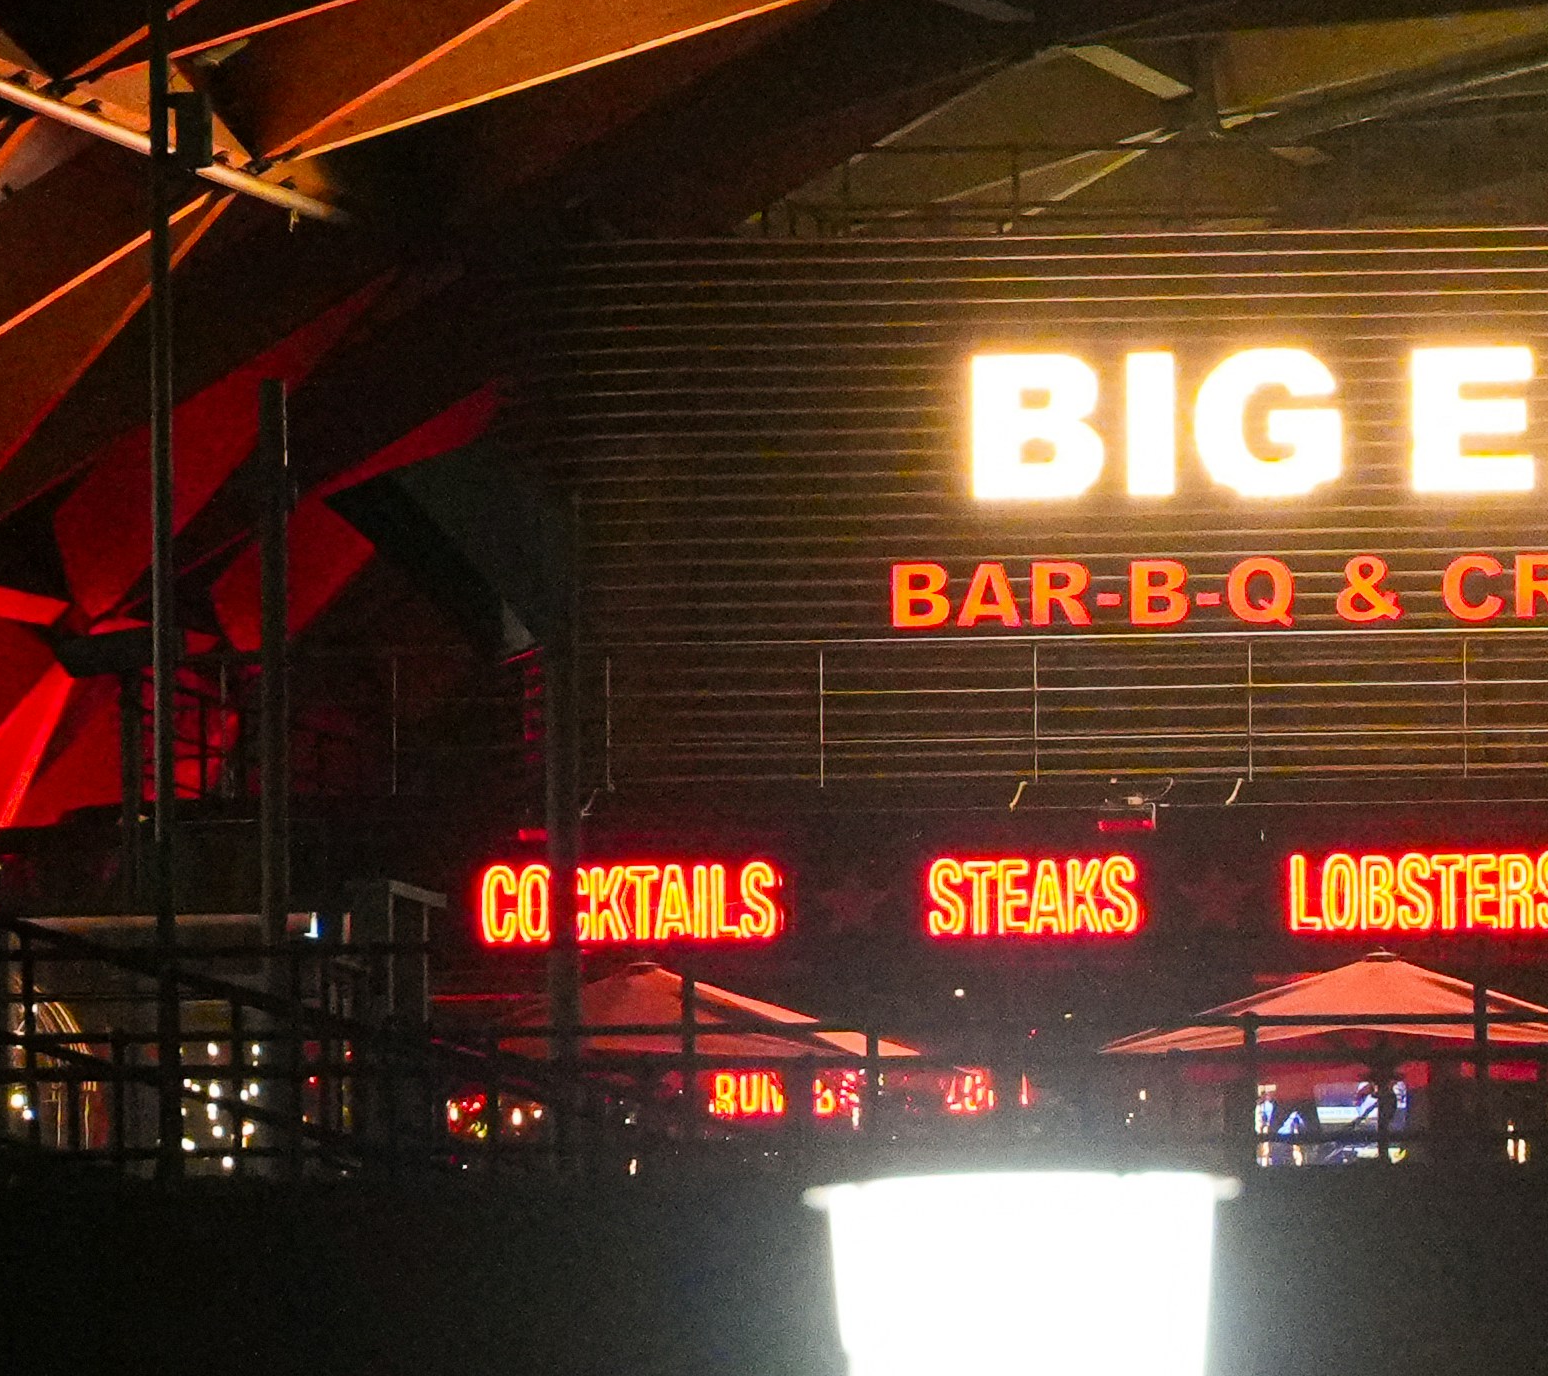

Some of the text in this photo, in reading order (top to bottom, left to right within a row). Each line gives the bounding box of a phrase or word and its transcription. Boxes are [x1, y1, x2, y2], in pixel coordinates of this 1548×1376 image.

[972, 348, 1342, 501] BIG
[890, 559, 1296, 629] BAR-B-Q
[1336, 554, 1405, 624] &
[928, 855, 1138, 936] STEAKS
